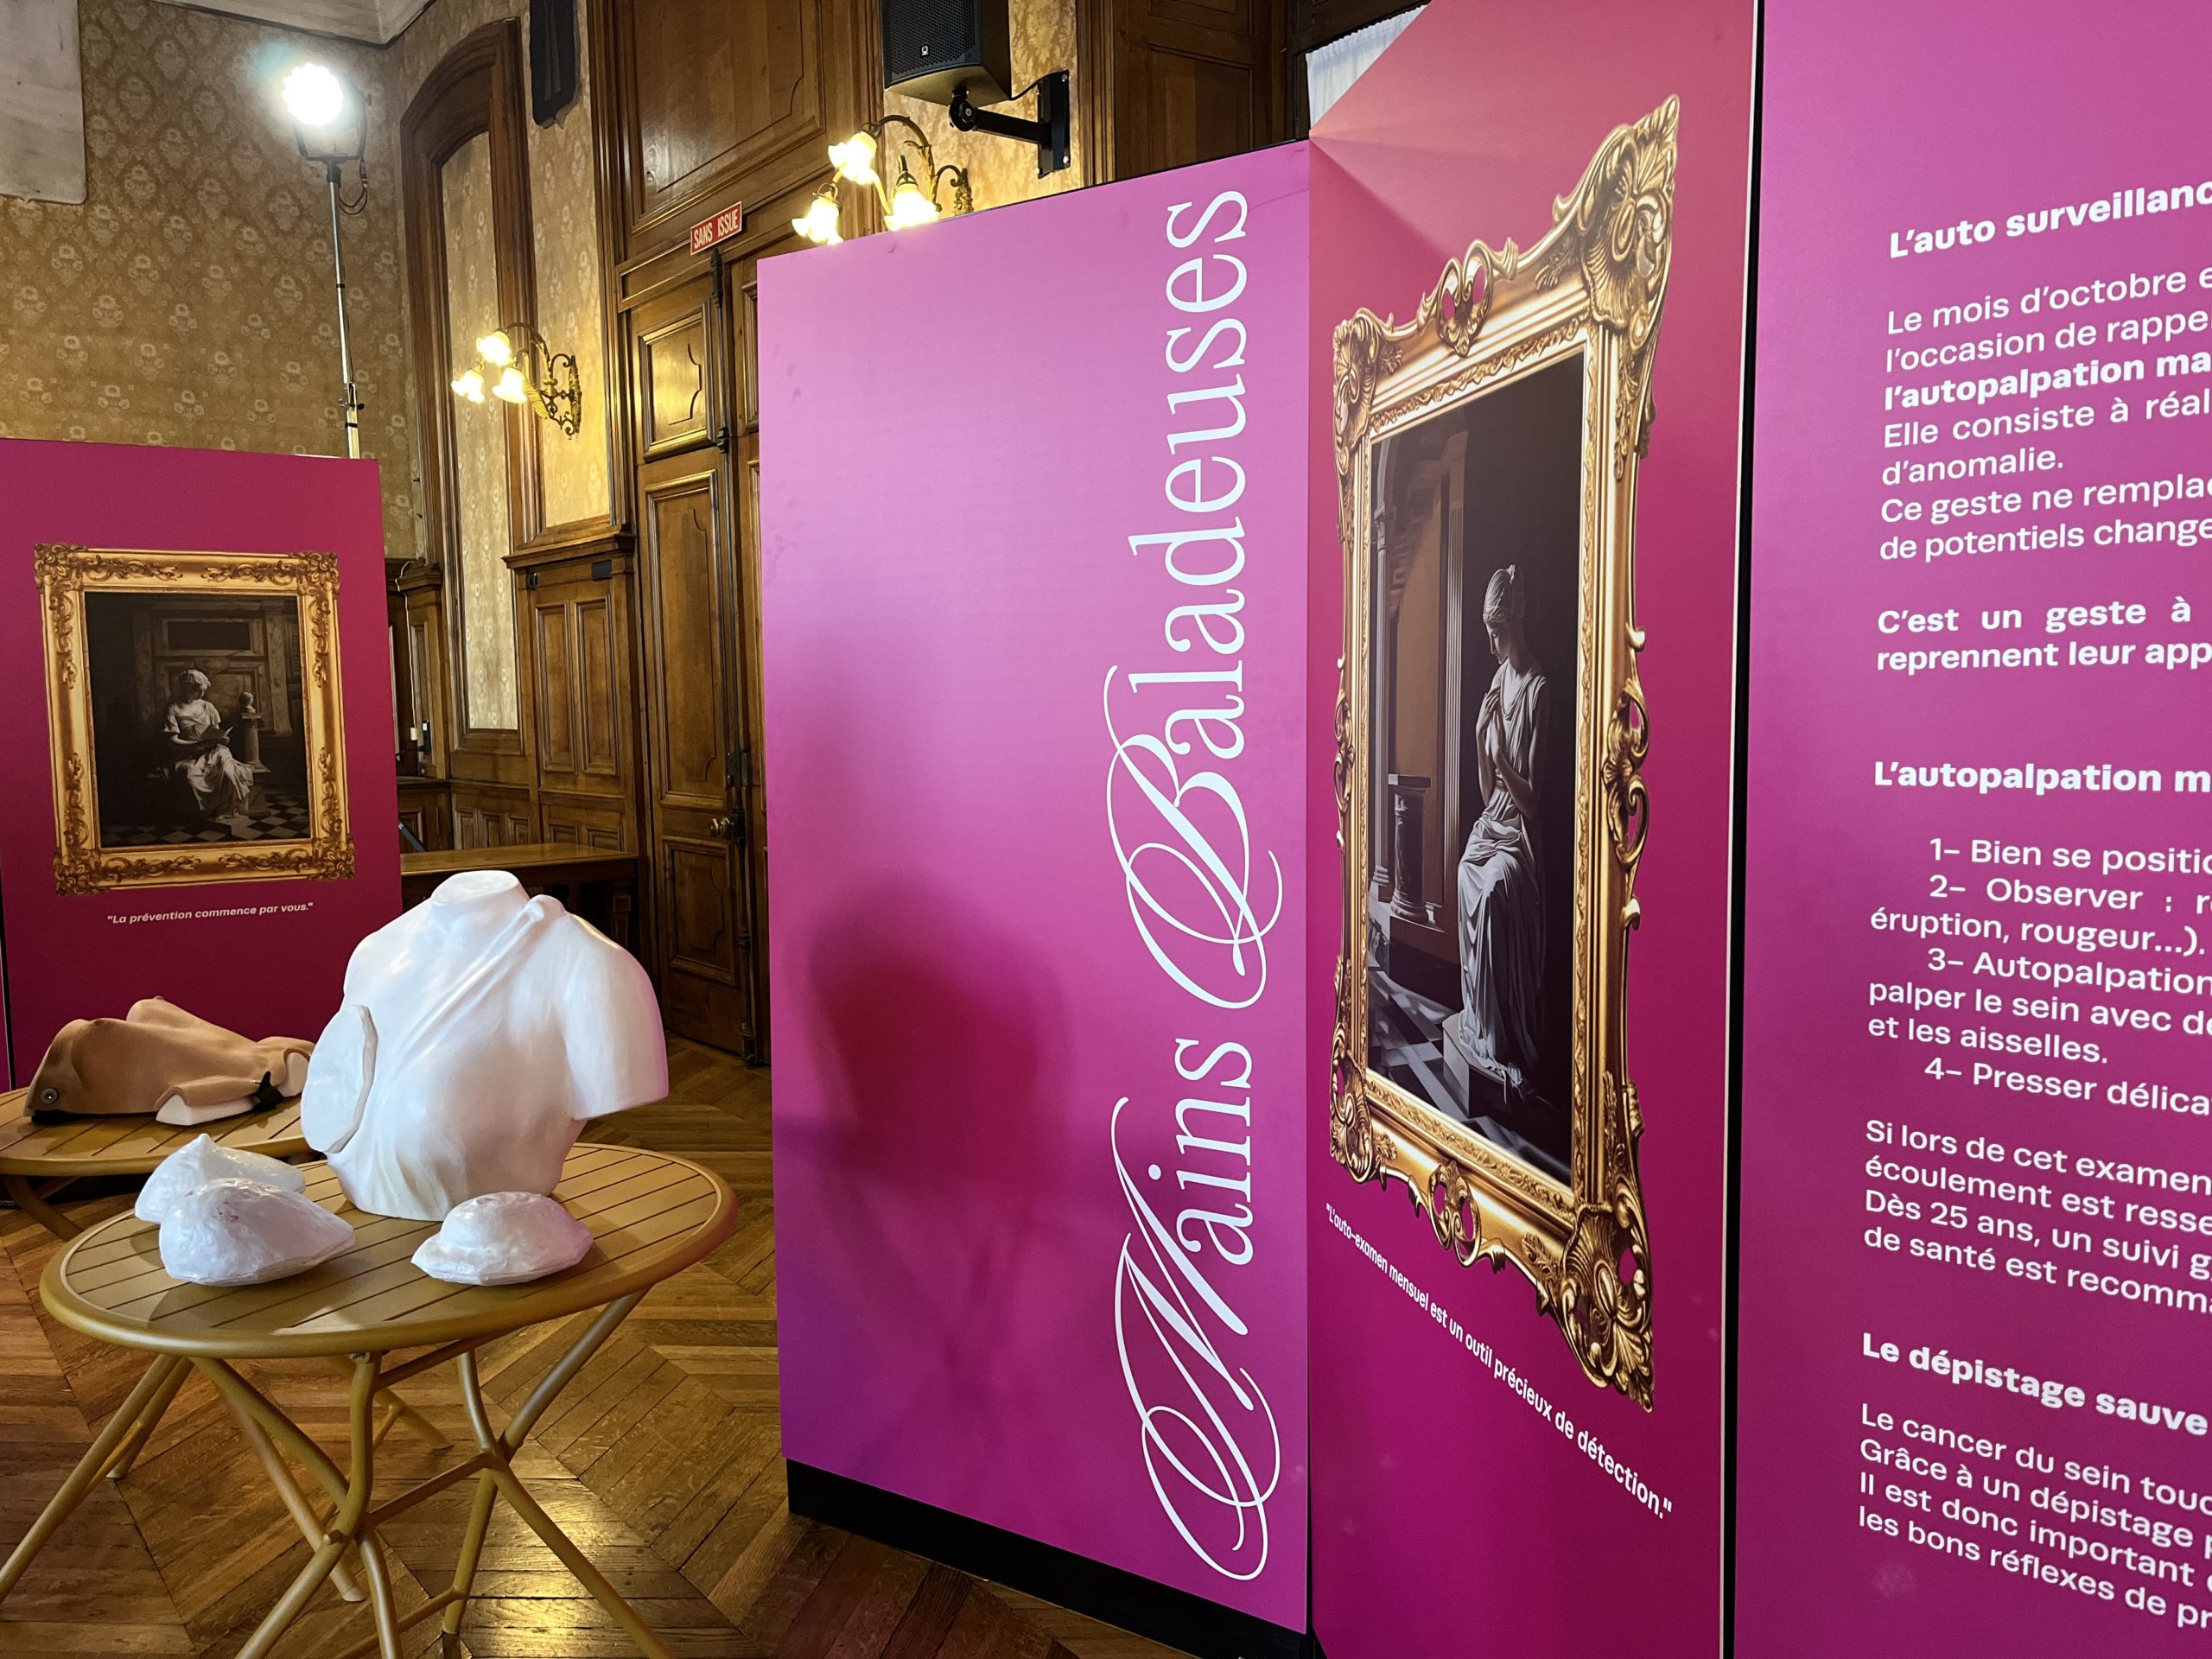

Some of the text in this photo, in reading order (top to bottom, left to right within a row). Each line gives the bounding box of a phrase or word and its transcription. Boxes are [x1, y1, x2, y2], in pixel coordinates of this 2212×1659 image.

[694, 208, 739, 250] SANS ISSUE
[1890, 181, 2212, 258] L'auto surveillanc
[1887, 310, 1923, 335] Le
[1933, 295, 2010, 328] mois
[2020, 271, 2187, 315] d'octobre
[1886, 310, 2212, 373] l'occasion de rappe
[1885, 351, 2212, 411] l'autopalpation ma
[1884, 387, 2210, 448] Elle consiste à réal
[1882, 447, 2063, 486] d'anomalie.
[1881, 498, 1923, 523] Ce
[1930, 491, 2022, 525] geste
[2031, 488, 2073, 511] ne
[1879, 518, 2212, 563] de potentiels change
[1878, 595, 2191, 634] C'est un geste à
[1877, 640, 2212, 676] reprennent leur app
[1874, 760, 2162, 796] L'autopalpation
[1971, 839, 2042, 866] Bien
[2052, 848, 2092, 868] se
[106, 901, 314, 925] "La prévention commence par vous."
[1103, 190, 1283, 1581] Mains Baladeuses
[1986, 877, 2144, 911] Observer
[2196, 894, 2212, 915] r
[1870, 906, 2205, 957] éruption, rougeur...).
[1972, 951, 2212, 996] Autopalpation
[1869, 981, 1967, 1011] palper
[1975, 988, 2003, 1014] le
[2012, 995, 2080, 1022] sein
[2089, 1005, 2172, 1032] avec
[1867, 1016, 2108, 1065] et les aisselles.
[1973, 1062, 2098, 1101] Presser
[2107, 1080, 2212, 1116] délica
[1866, 1119, 2212, 1197] Si lors de cet examen
[1865, 1154, 2212, 1236] écoulement est resse
[1864, 1225, 1901, 1252] de
[1909, 1237, 1996, 1271] santé
[2005, 1257, 2058, 1285] est
[1866, 1189, 2212, 1282] Dès 25 ans, un suivi g
[1325, 1202, 1673, 1520] "L'auto-examen mensuel est un outil précieux de détection."
[1862, 1332, 2209, 1436] Le dépistage sauve
[1861, 1402, 2212, 1516] Le cancer du sein touc
[1859, 1438, 1948, 1481] Grâce
[1955, 1463, 1974, 1490] à
[1982, 1475, 2021, 1502] un
[2030, 1486, 2194, 1548] dépistage
[1860, 1471, 1875, 1496] Il
[1885, 1484, 1933, 1513] est
[1942, 1497, 2018, 1536] donc
[2029, 1519, 2196, 1588] important
[1859, 1505, 1899, 1537] les
[1908, 1520, 1981, 1561] bons
[1990, 1548, 2115, 1601] réflexes
[2124, 1586, 2167, 1616] de
